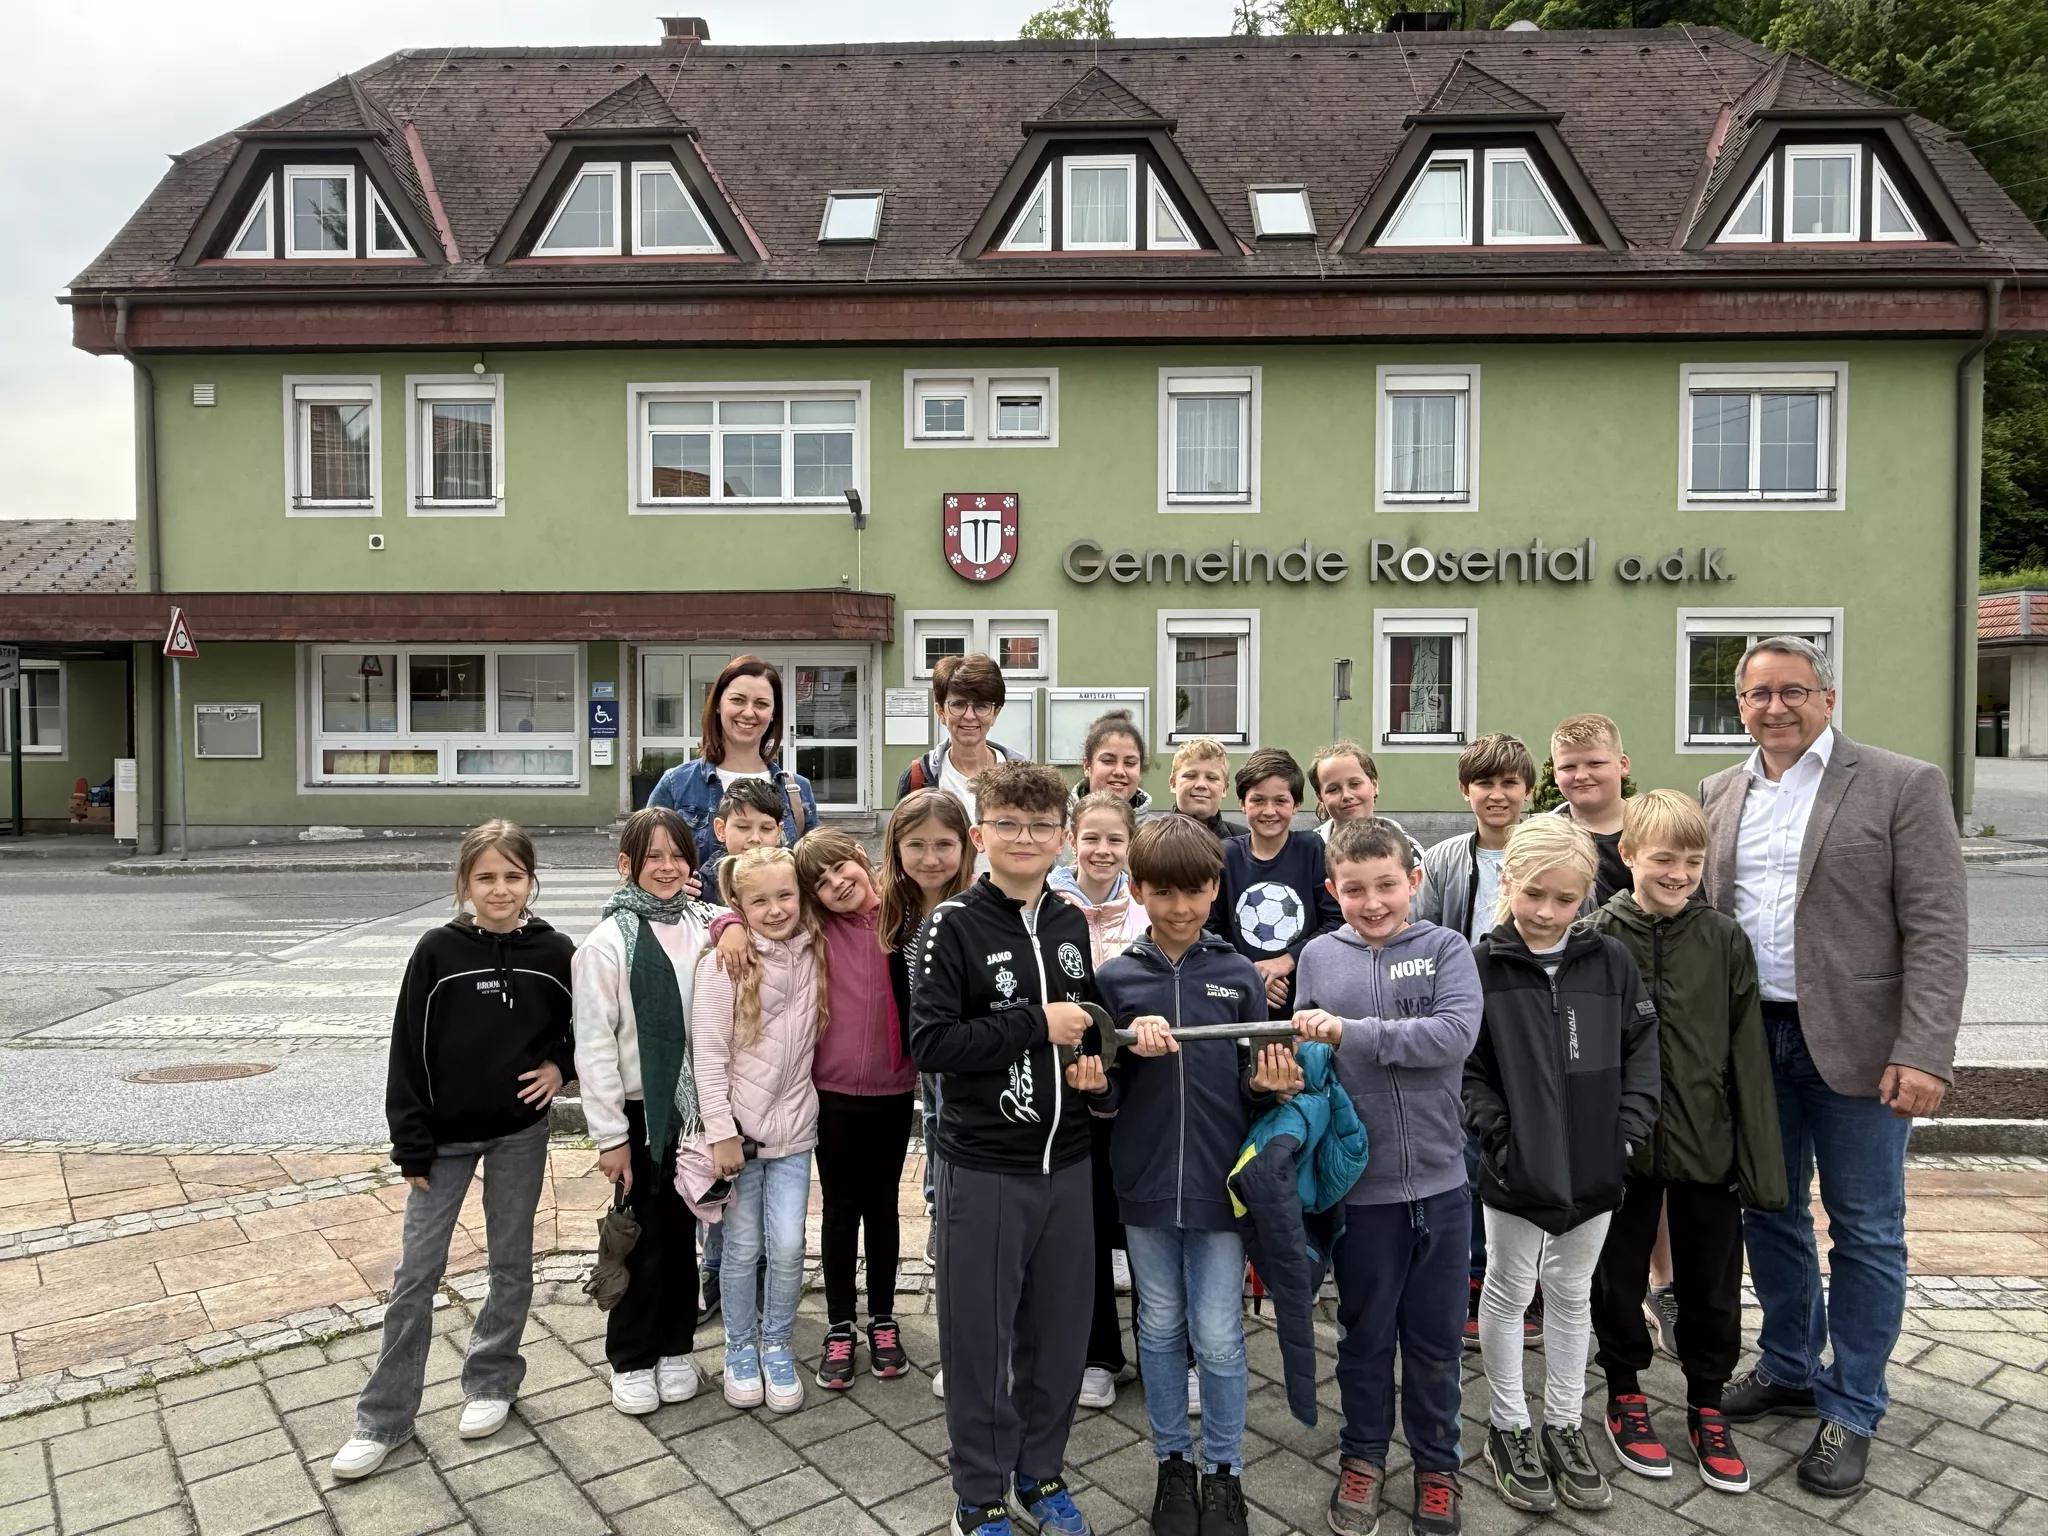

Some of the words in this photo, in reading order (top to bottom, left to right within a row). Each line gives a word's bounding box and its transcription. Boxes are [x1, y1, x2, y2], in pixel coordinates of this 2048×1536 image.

[1062, 538, 1349, 583] Gemeinde
[1369, 537, 1596, 582] Rosental
[986, 951, 1012, 965] JAKO
[1390, 957, 1436, 980] NOPE
[1395, 996, 1433, 1017] NOP
[1040, 1481, 1059, 1496] FILA
[986, 1506, 1006, 1518] FILA
